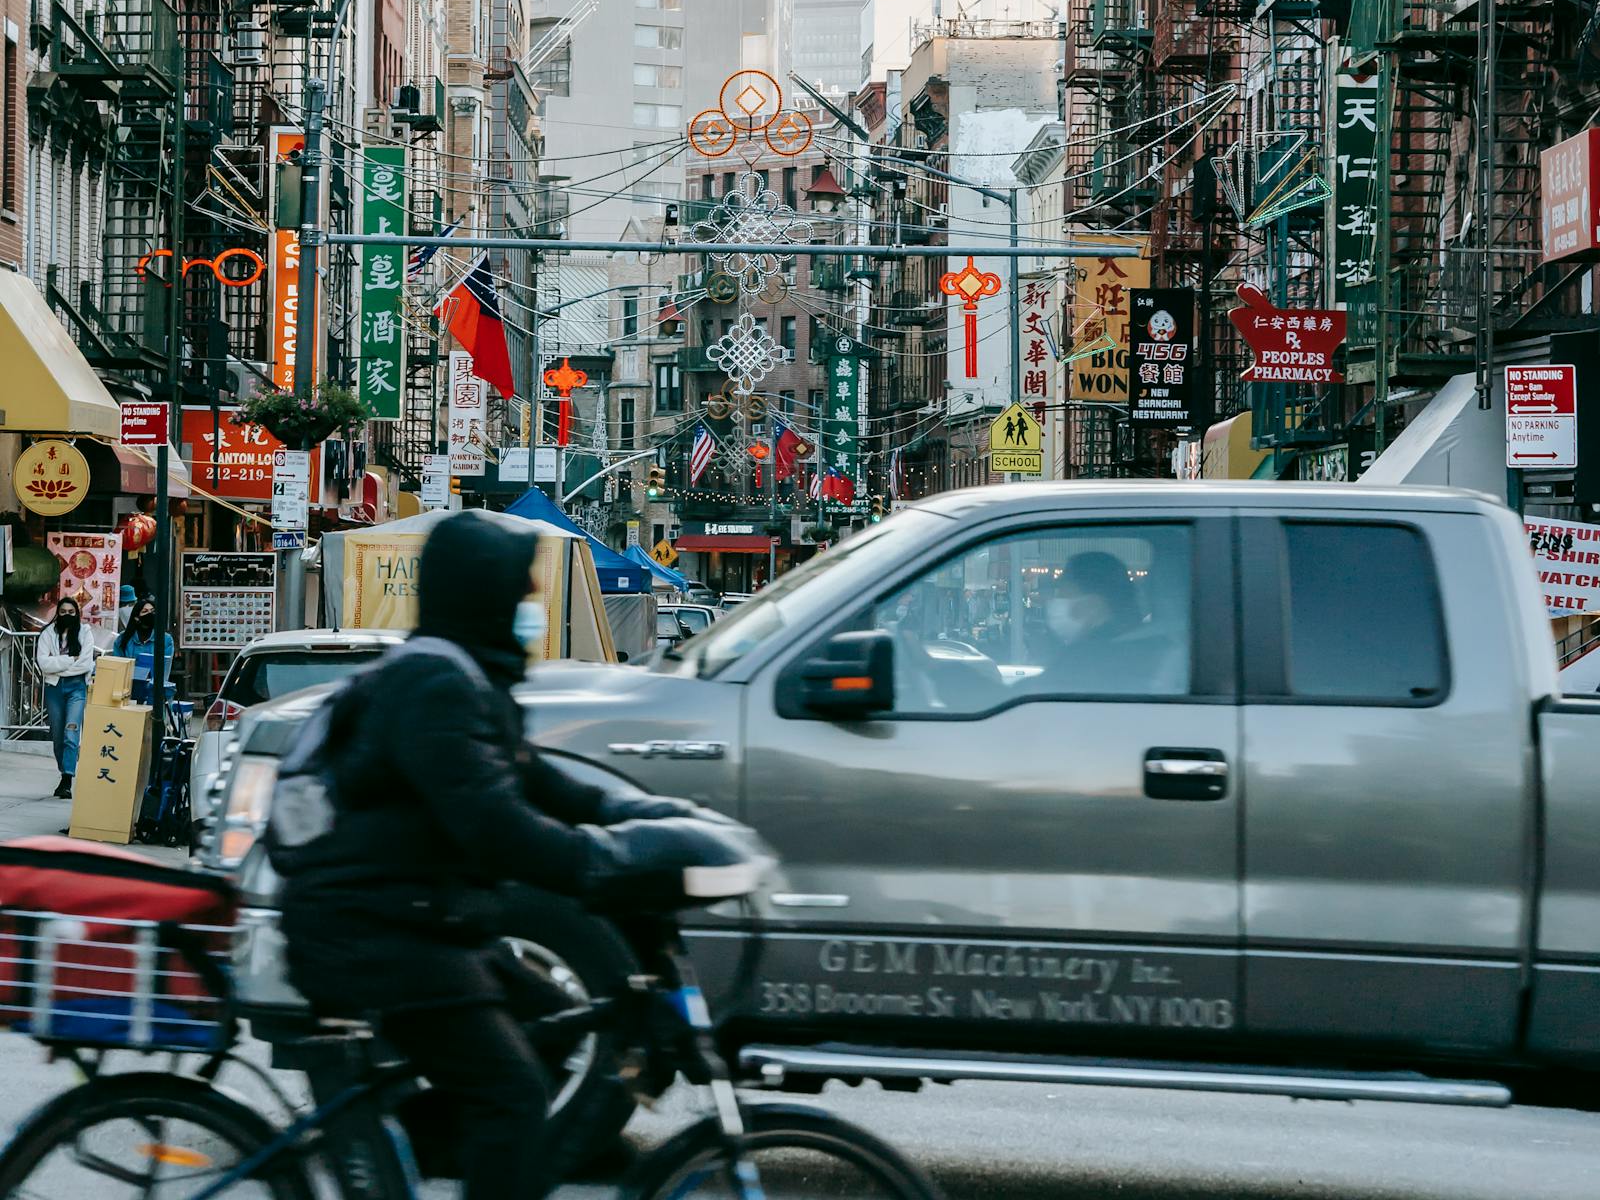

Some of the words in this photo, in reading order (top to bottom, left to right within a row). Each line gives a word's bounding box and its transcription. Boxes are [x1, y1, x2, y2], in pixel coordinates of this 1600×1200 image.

[1335, 98, 1378, 284] 天仁茗茶
[1253, 315, 1334, 332] 仁安西藥房
[1091, 349, 1130, 369] BIG
[1136, 342, 1187, 361] 456
[1261, 350, 1325, 365] PEOPLES
[1022, 282, 1051, 454] 新文華閣酒
[1139, 363, 1184, 385] 餐館
[1253, 367, 1333, 382] PHARMACY
[1509, 371, 1521, 381] NO
[1522, 370, 1564, 381] STANDING
[1079, 373, 1129, 394] WON
[1509, 383, 1524, 392] 7am
[1150, 388, 1170, 398] NEW
[1509, 392, 1531, 402] Except
[1532, 392, 1556, 403] Sunday
[123, 407, 132, 416] NO
[132, 407, 161, 416] STANDING
[1138, 399, 1182, 409] SHANGHAI
[123, 417, 147, 427] Anytime
[1132, 410, 1189, 420] RESTAURANT
[1511, 420, 1522, 430] NO
[1525, 420, 1560, 430] PARKING
[1511, 433, 1545, 444] Anytime
[995, 456, 1038, 467] SCHOOL
[206, 467, 273, 481] 212-219-
[377, 556, 421, 580] HAP
[383, 582, 420, 597] RES
[932, 944, 1121, 994] Machinery
[814, 983, 922, 1015] Broome
[971, 988, 1033, 1020] New
[1109, 994, 1158, 1024] NY
